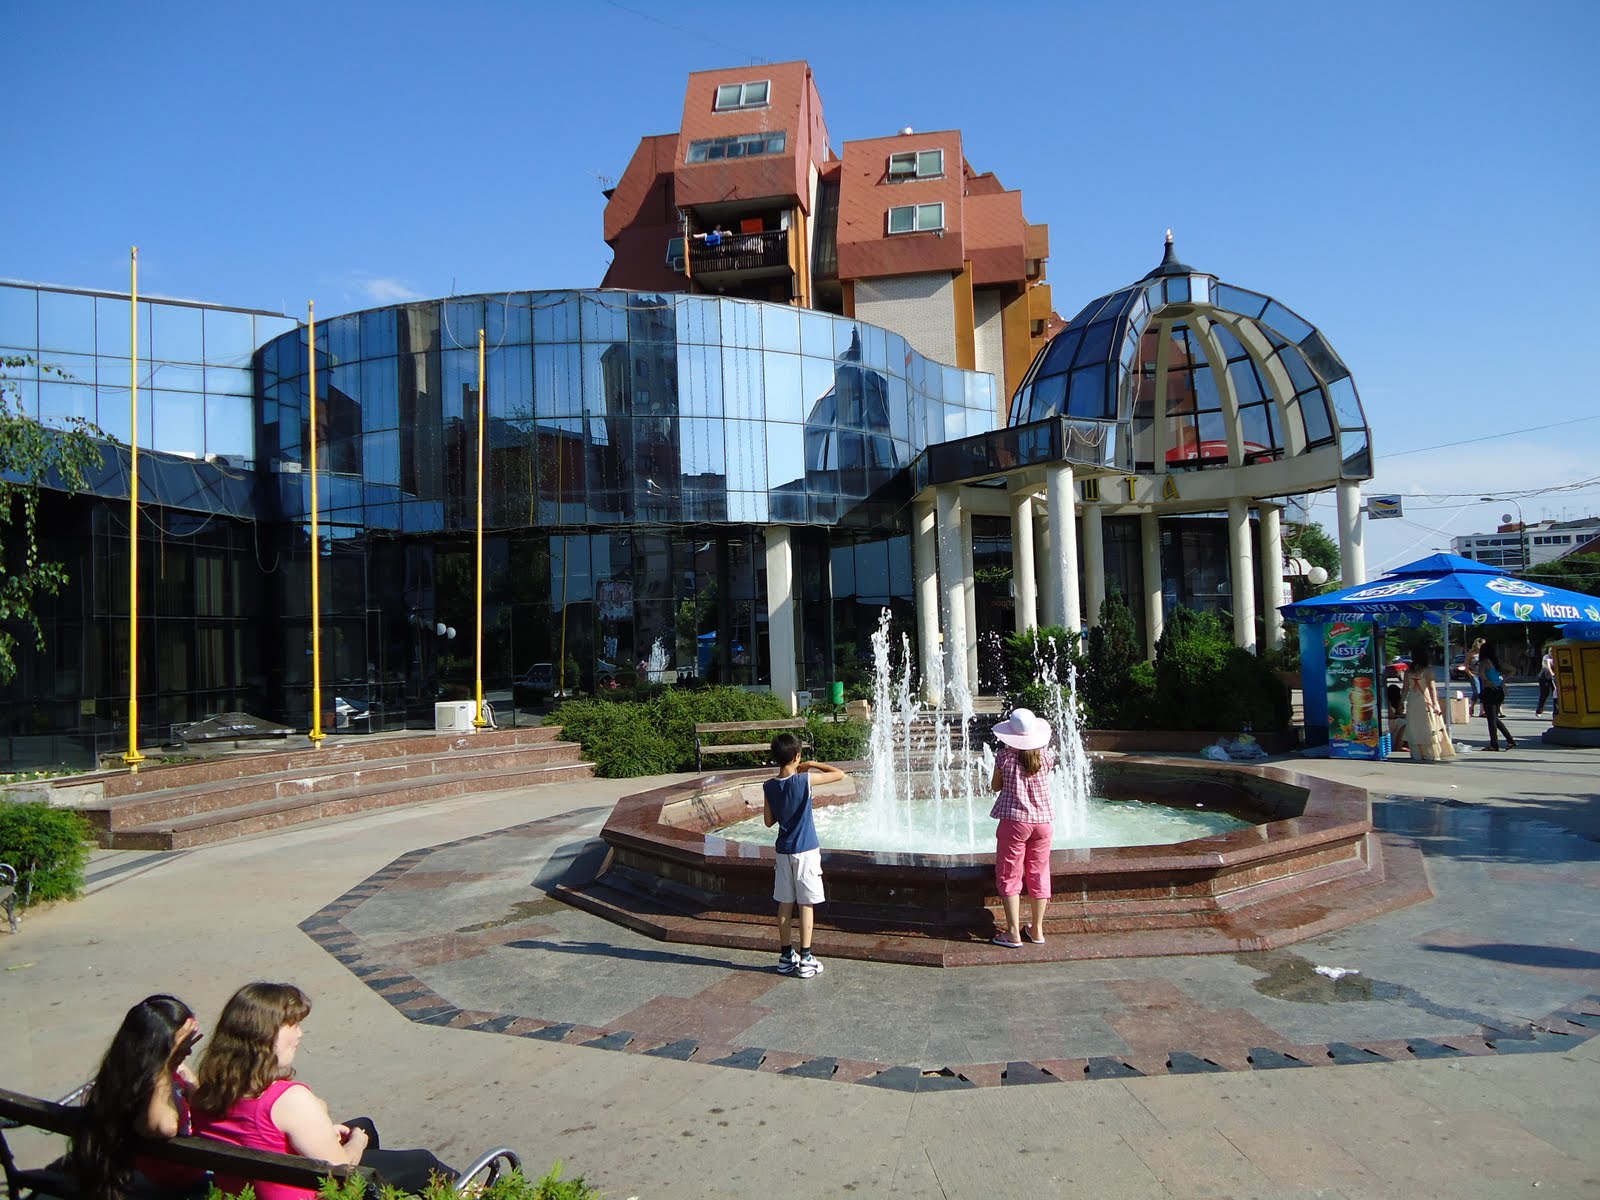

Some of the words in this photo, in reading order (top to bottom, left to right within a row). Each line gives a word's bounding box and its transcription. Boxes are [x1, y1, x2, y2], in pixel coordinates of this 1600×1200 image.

[1081, 475, 1180, 501] ШТА
[1356, 603, 1399, 612] NESTEA
[1541, 603, 1580, 619] NESTEA
[1331, 647, 1366, 656] NESTEA
